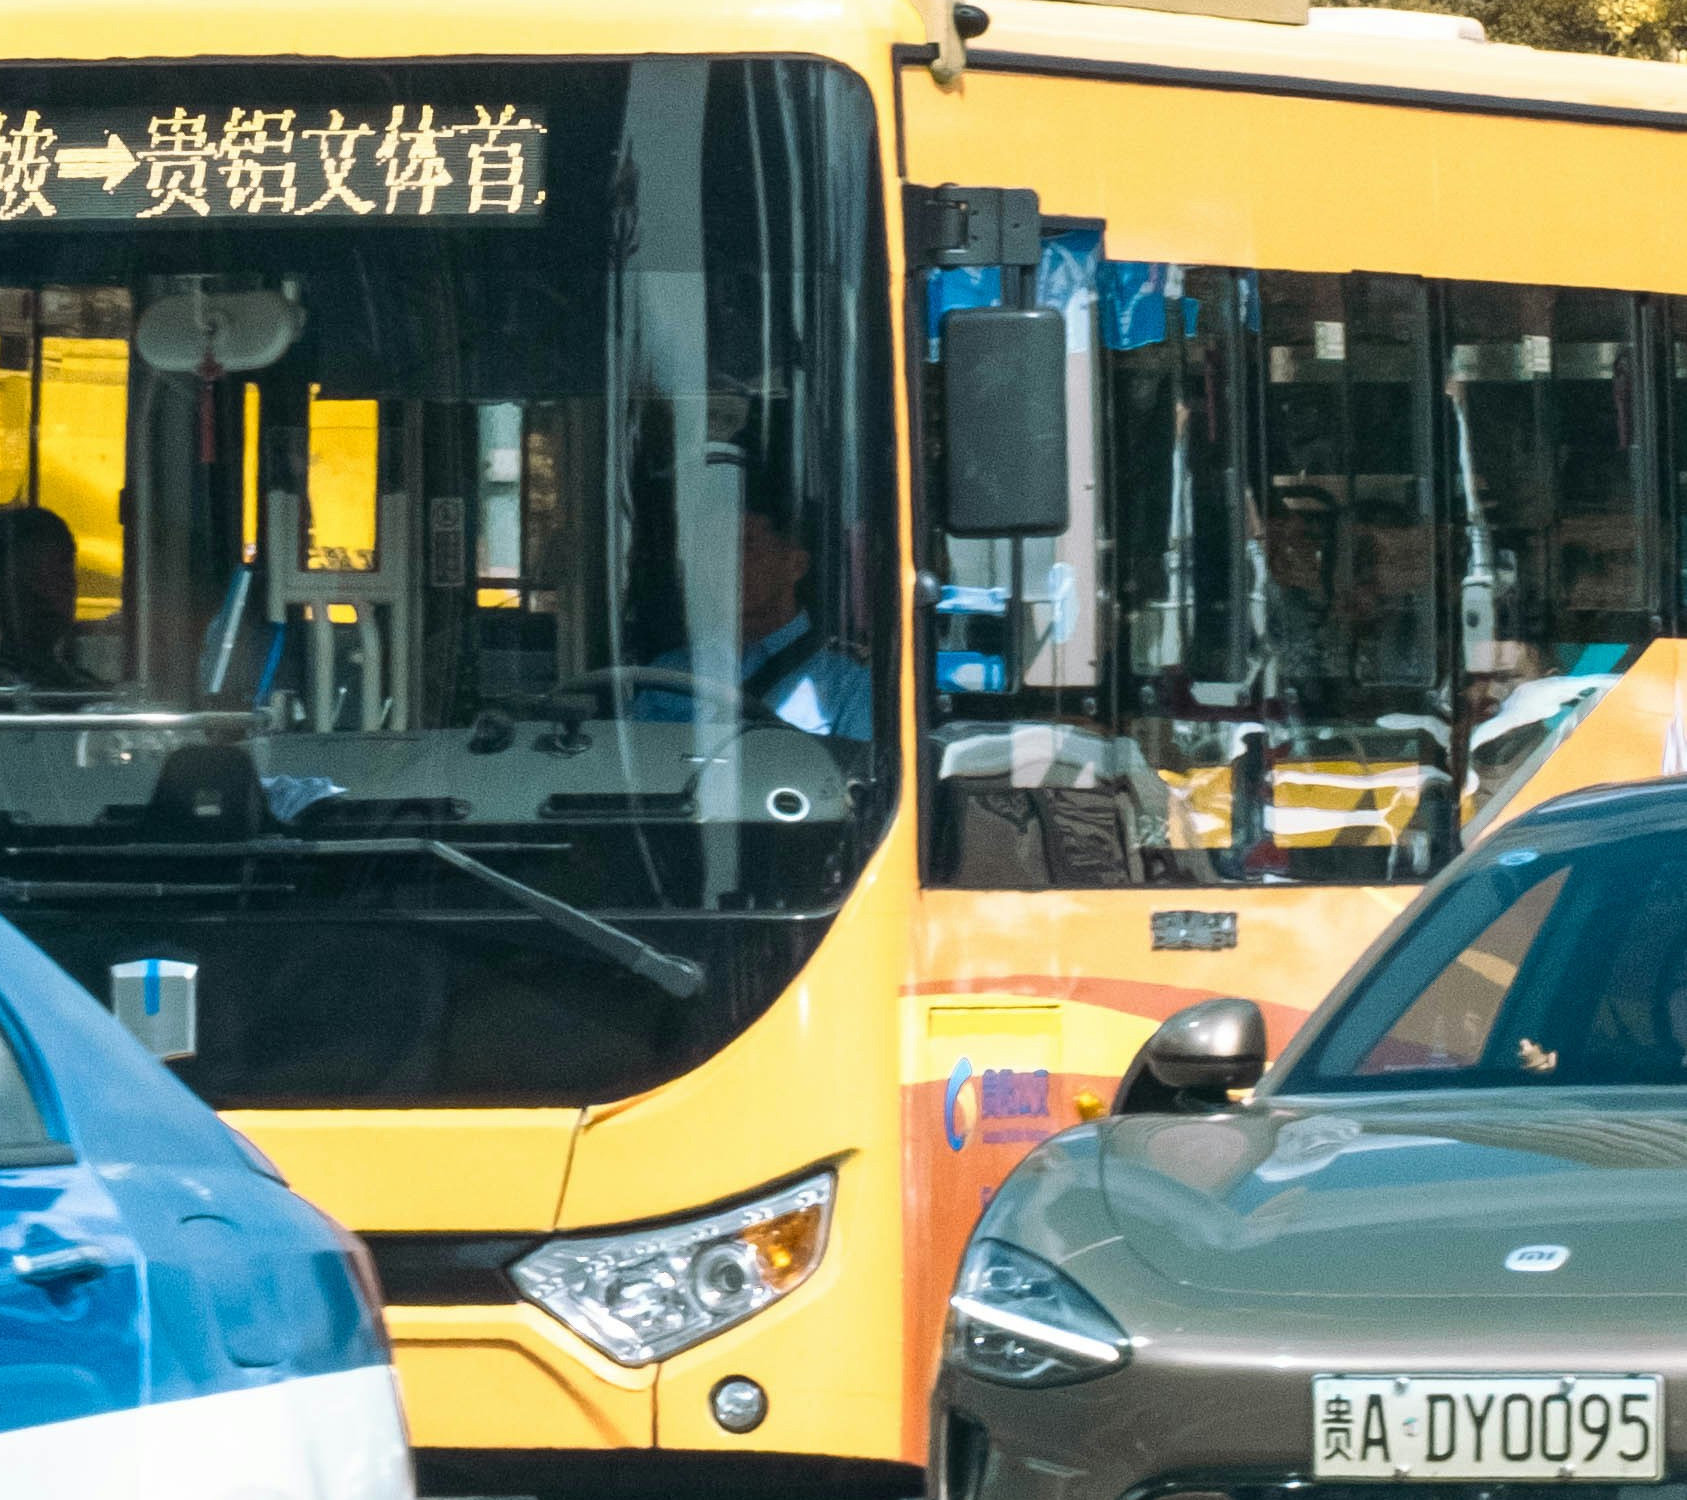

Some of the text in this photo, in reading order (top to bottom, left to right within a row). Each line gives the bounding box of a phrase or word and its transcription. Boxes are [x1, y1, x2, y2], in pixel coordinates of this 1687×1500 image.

[136, 104, 548, 219] 贵铝文体首
